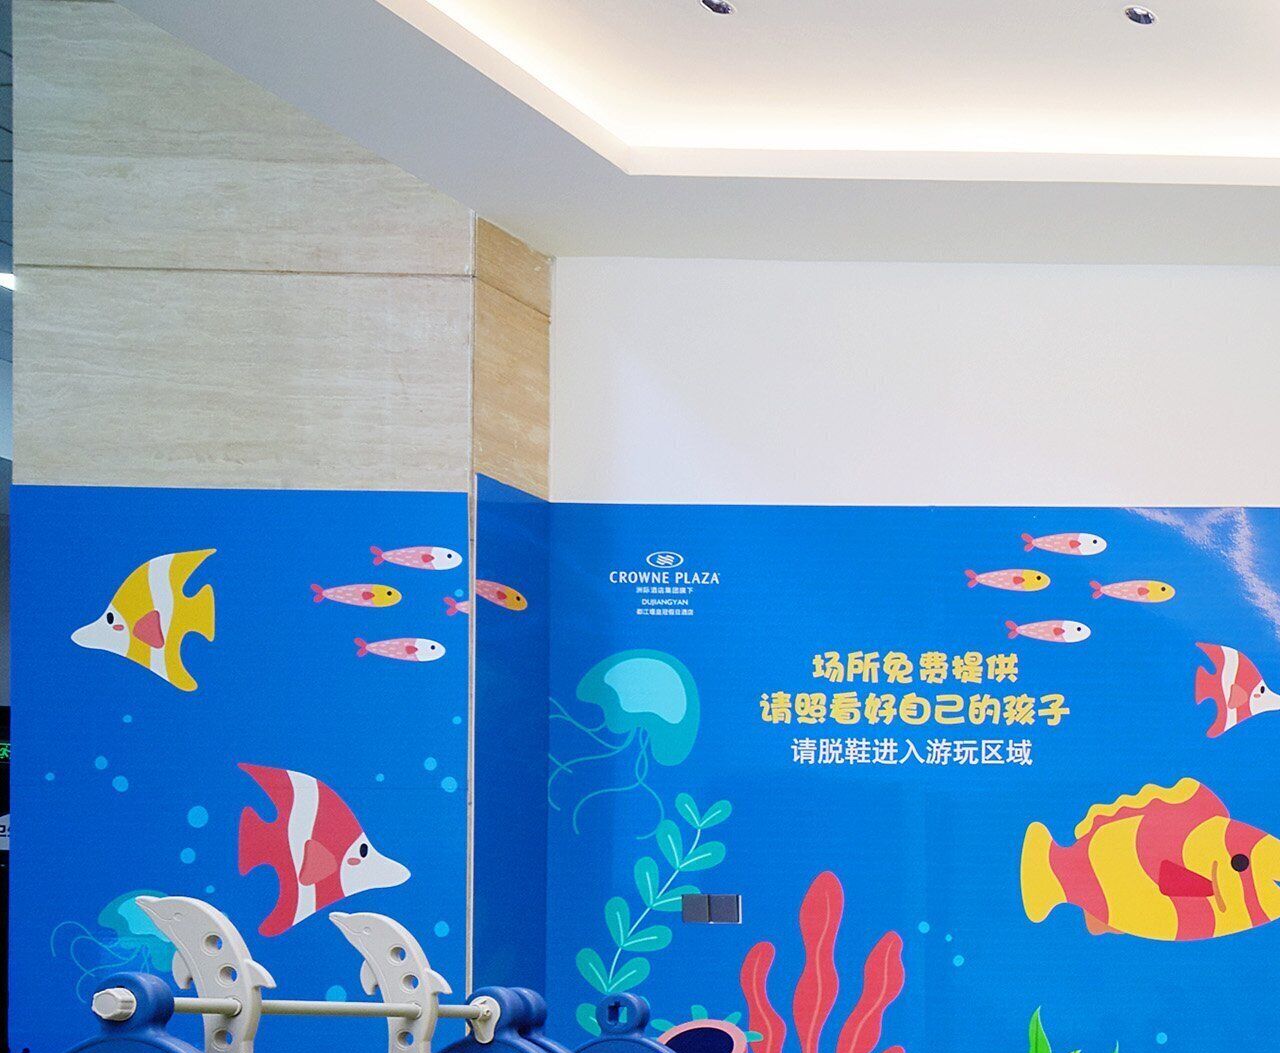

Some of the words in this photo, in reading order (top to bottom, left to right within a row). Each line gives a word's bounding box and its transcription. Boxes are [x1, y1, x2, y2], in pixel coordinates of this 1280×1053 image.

[609, 571, 669, 584] CROWNE
[675, 571, 720, 585] PLAZA
[641, 598, 689, 606] DUJIANGYAN
[812, 650, 1019, 684] 场所免费提供
[759, 691, 1071, 726] 请照看好自己的孩子
[790, 737, 1034, 766] 请脱鞋进入游玩区域
